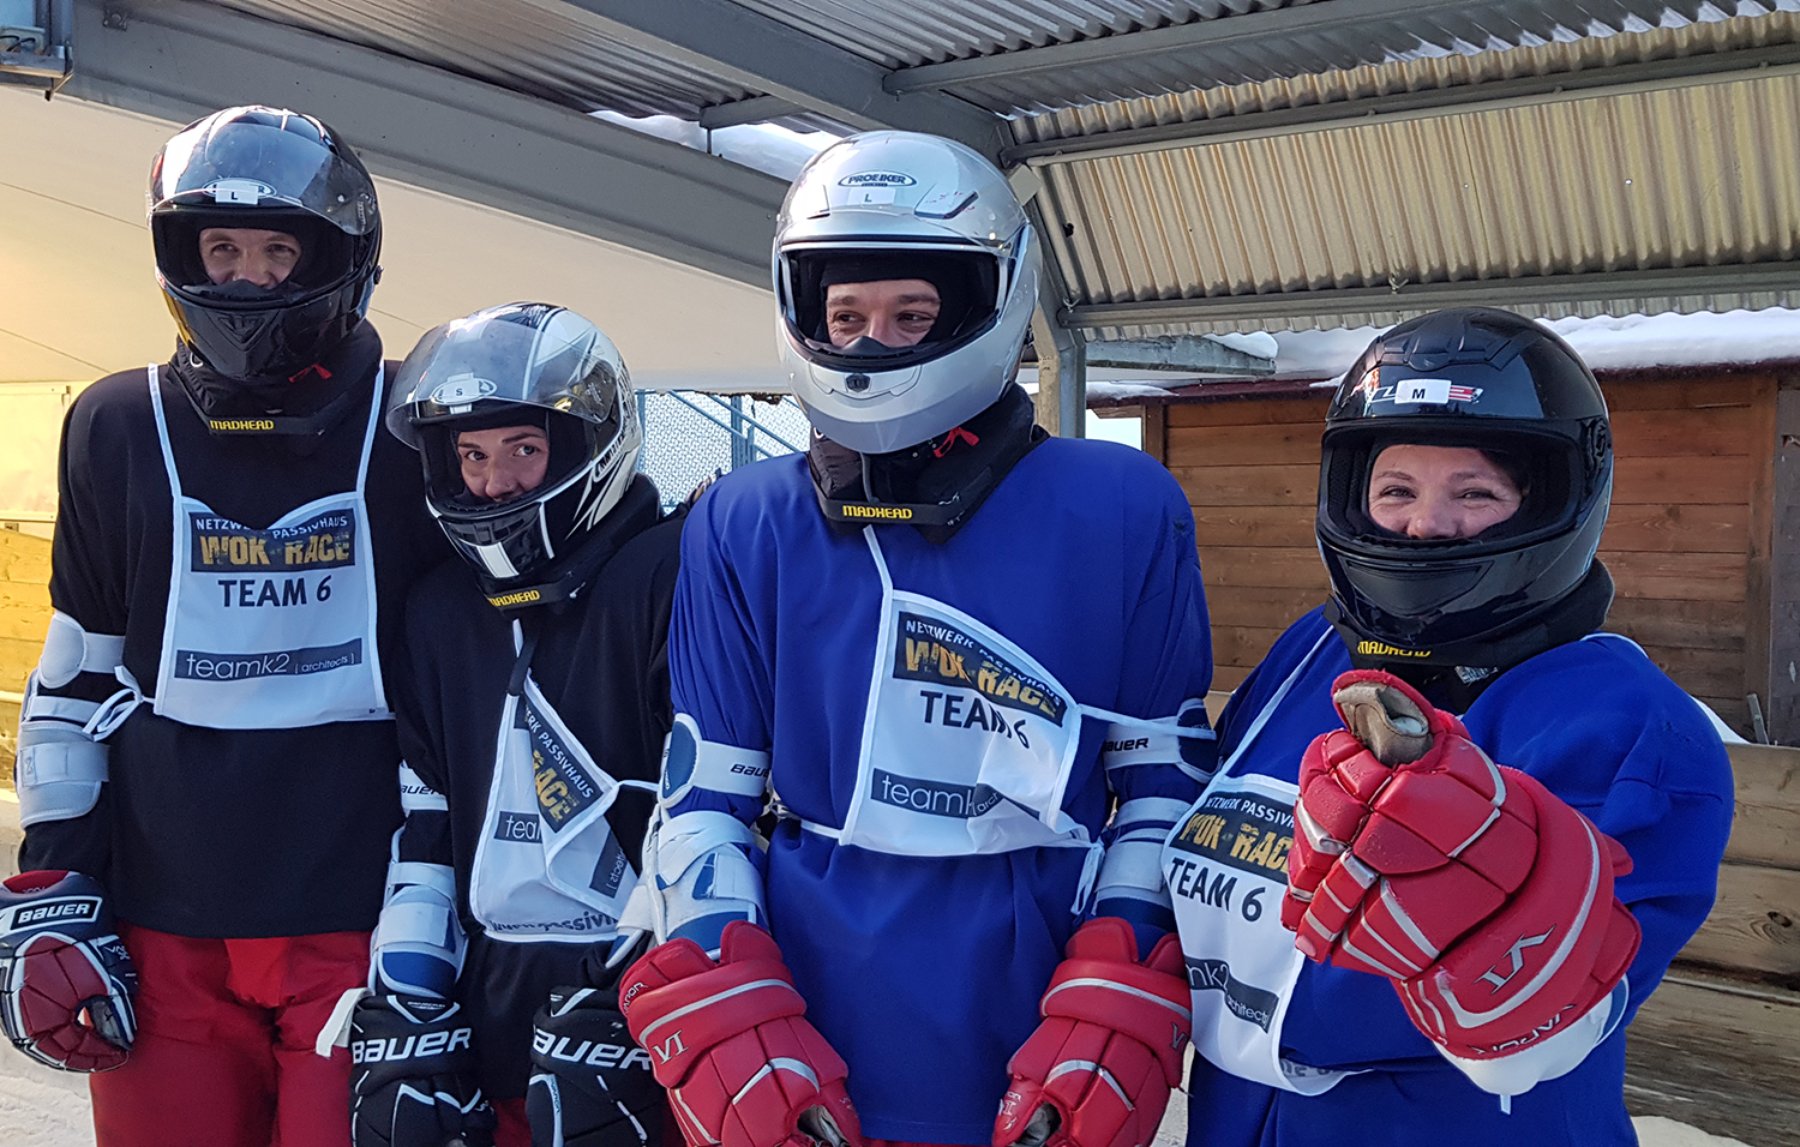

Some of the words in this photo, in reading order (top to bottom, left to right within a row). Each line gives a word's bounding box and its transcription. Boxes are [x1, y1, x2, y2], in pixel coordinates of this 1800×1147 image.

[231, 192, 238, 200] L
[865, 194, 872, 202] L
[456, 388, 463, 397] S
[1412, 388, 1426, 399] M
[209, 420, 274, 430] MADHEAD
[842, 505, 913, 518] MADHEAD
[218, 578, 307, 607] TEAM
[316, 575, 332, 601] 6
[186, 653, 290, 679] teamk2
[538, 732, 594, 799] PASSIVHAUS
[1170, 857, 1238, 912] TEAM
[1241, 887, 1266, 922] 6
[533, 1027, 652, 1070] AUER
[653, 1030, 688, 1065] VI
